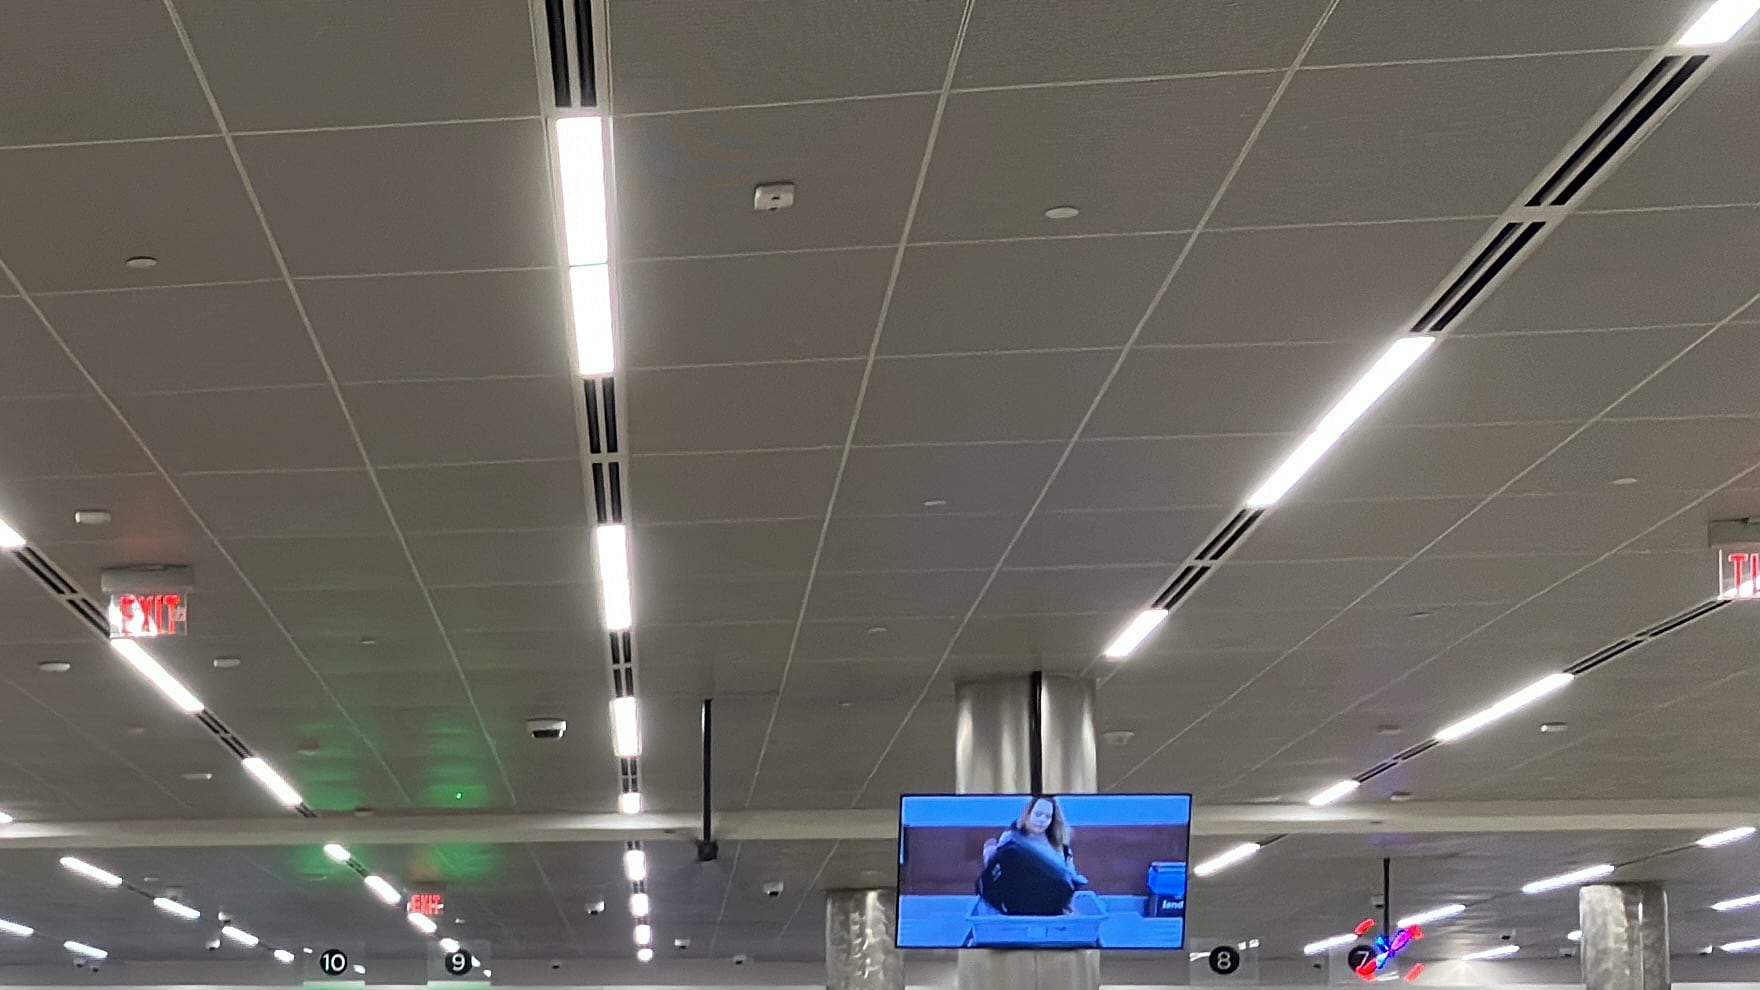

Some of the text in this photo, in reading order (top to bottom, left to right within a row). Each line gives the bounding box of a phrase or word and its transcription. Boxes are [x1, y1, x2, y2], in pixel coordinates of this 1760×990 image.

[119, 594, 181, 635] EXIT
[411, 893, 442, 915] EXIT
[322, 953, 346, 971] 10
[451, 953, 466, 971] 9
[1216, 951, 1232, 970] 8
[1356, 950, 1370, 970] 7
